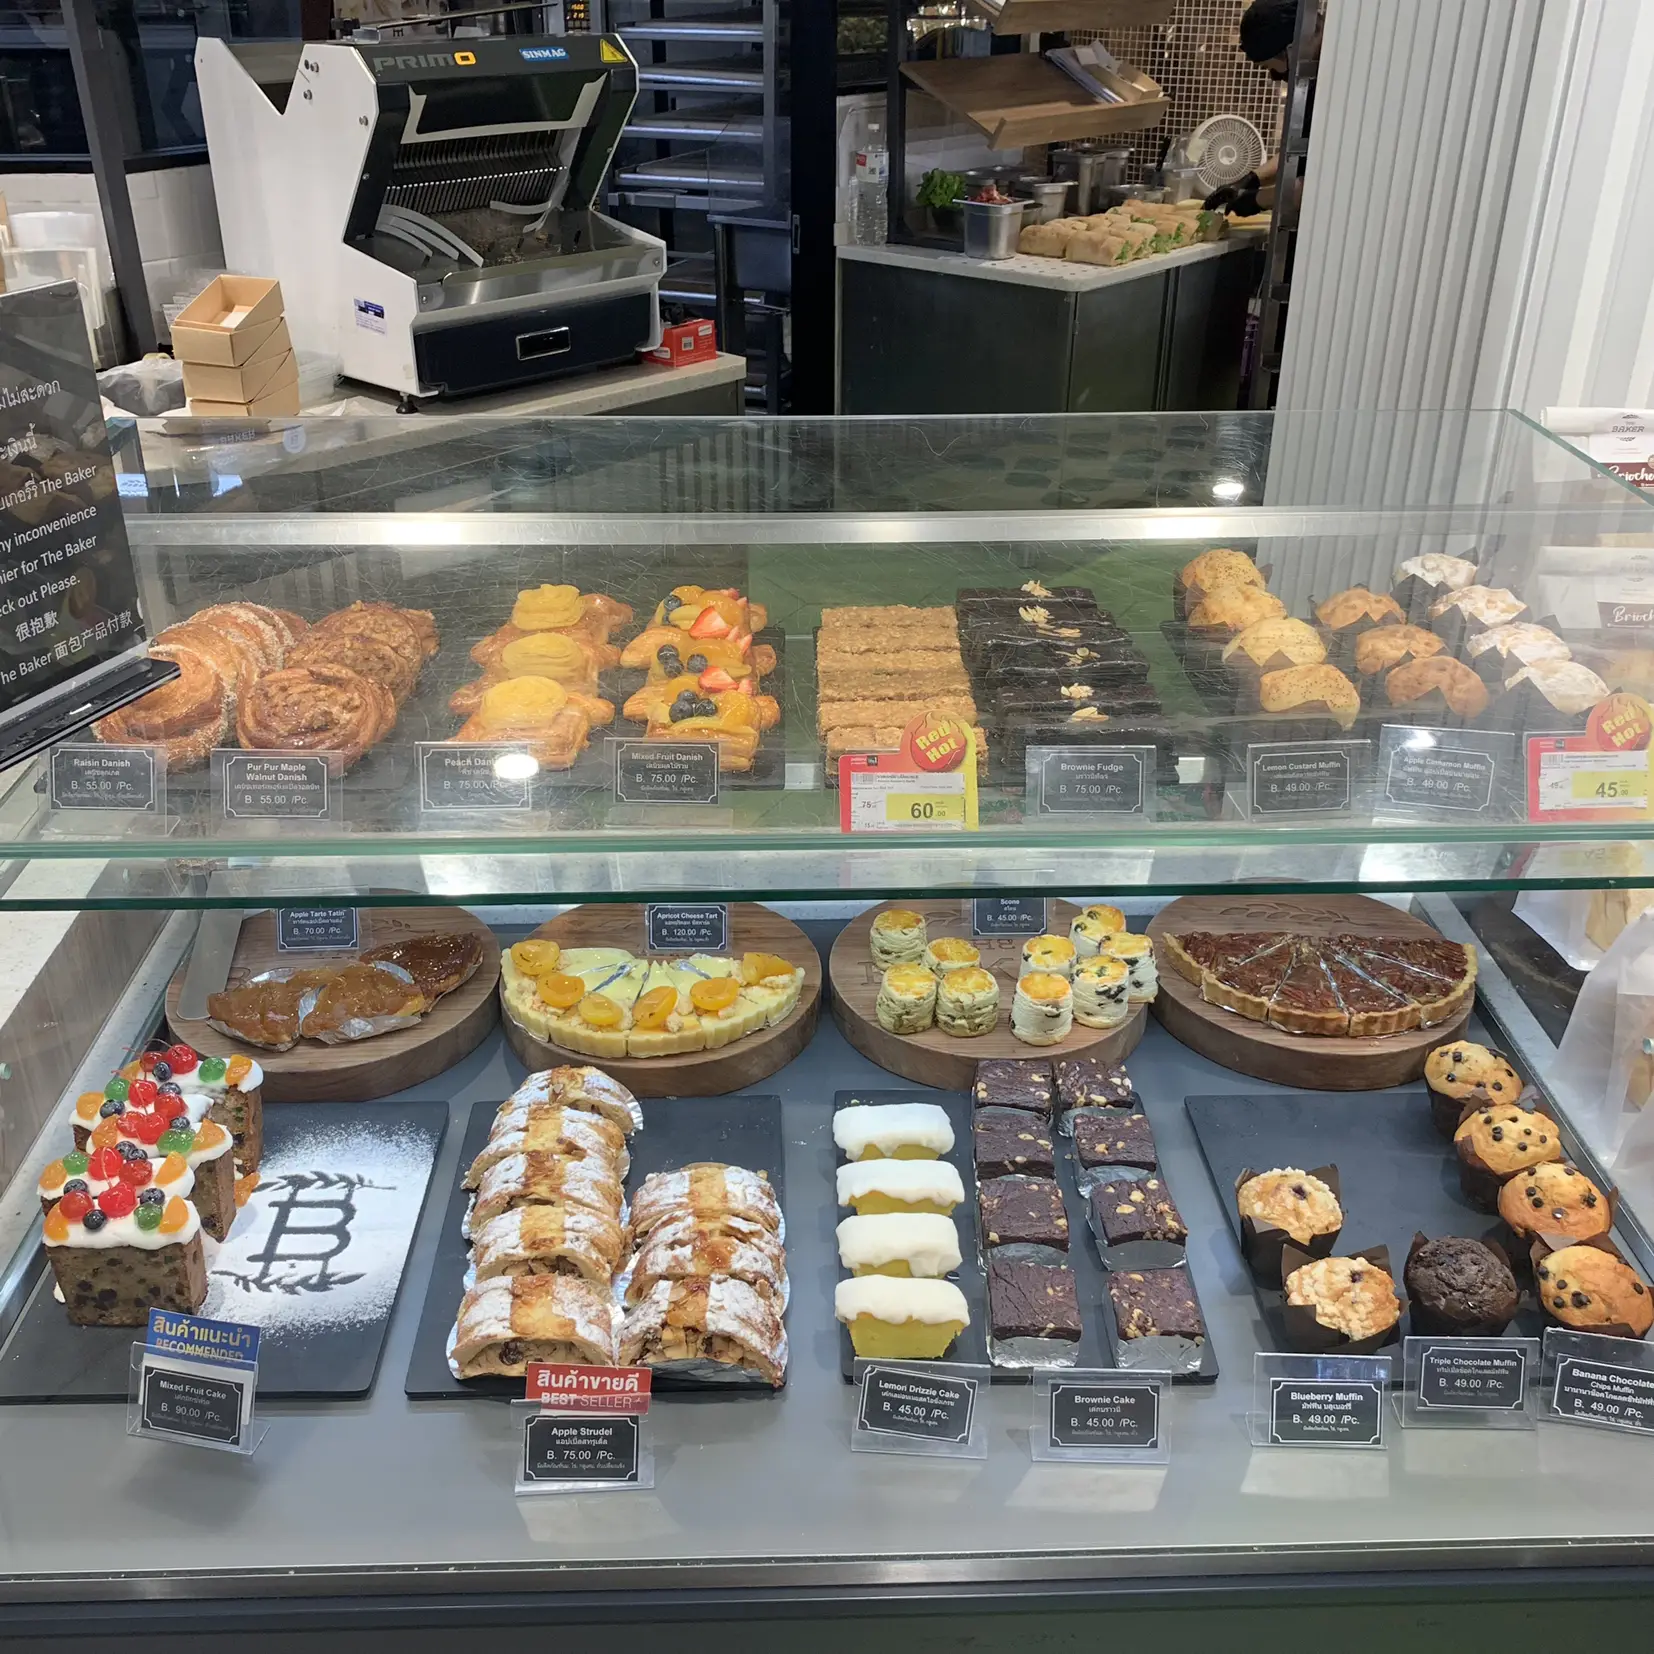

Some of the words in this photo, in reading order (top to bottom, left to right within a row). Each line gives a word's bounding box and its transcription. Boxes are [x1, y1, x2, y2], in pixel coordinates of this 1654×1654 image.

[521, 48, 566, 59] SINMAG
[373, 51, 477, 71] PRIMO
[1612, 425, 1645, 433] BAKER
[40, 478, 63, 494] The
[64, 465, 97, 486] Baker
[13, 506, 97, 547] inconvenience
[20, 559, 39, 575] for
[40, 550, 63, 567] The
[65, 535, 97, 557] Baker
[17, 590, 39, 608] out
[40, 574, 81, 599] Please.
[15, 610, 60, 642] 很抱歉
[18, 652, 52, 676] Baker
[53, 610, 133, 660] 面包产品付款
[915, 719, 951, 750] Red
[926, 736, 958, 763] Hot
[445, 758, 472, 767] Peach
[676, 753, 703, 761] Danish
[73, 758, 100, 767] Raisin
[101, 759, 131, 768] Danish
[247, 763, 262, 771] Pur
[264, 763, 279, 771] Pur
[280, 763, 307, 773] Maple
[1061, 763, 1095, 771] Brownie
[1097, 763, 1124, 773] Fudge
[1288, 762, 1317, 770] Custard
[1319, 761, 1341, 769] Muffin
[246, 773, 277, 781] Walnut
[278, 773, 307, 781] Danish
[651, 774, 676, 783] 75.00
[86, 781, 112, 790] 55.00
[1075, 785, 1101, 794] 75.00
[1596, 782, 1618, 798] 45
[260, 795, 286, 804] 55.00
[911, 802, 934, 819] 60
[290, 911, 309, 919] Apple
[153, 1315, 251, 1349] สินค้าแนะนำ
[1430, 1357, 1451, 1367] Triple
[1453, 1359, 1491, 1367] Chocolate
[1493, 1359, 1517, 1367] Muffin
[537, 1369, 639, 1392] สินค้าขายดี
[1439, 1378, 1448, 1387] B.
[1454, 1378, 1481, 1388] 49.00
[1572, 1368, 1607, 1381] Banana
[1609, 1374, 1654, 1389] Chocolate
[160, 1380, 183, 1392] Mixed
[185, 1384, 204, 1395] Fruit
[205, 1387, 227, 1399] Cake
[879, 1380, 907, 1391] Lemon
[909, 1384, 937, 1396] Drizzle
[939, 1387, 960, 1399] Cake
[1590, 1381, 1612, 1391] Chips
[1613, 1384, 1635, 1394] Muffin
[540, 1392, 577, 1406] BEST
[580, 1394, 632, 1409] SELLER
[1075, 1395, 1111, 1404] Brownie
[1113, 1395, 1135, 1404] Cake
[1291, 1392, 1333, 1402] Blueberry
[1335, 1392, 1363, 1401] Muffin
[161, 1402, 170, 1412] B.
[175, 1405, 200, 1418] 90.00
[883, 1402, 892, 1412] B.
[898, 1404, 926, 1417] 45.00
[930, 1409, 949, 1420] /Pc.
[1574, 1398, 1585, 1408] B.
[1590, 1401, 1620, 1414] 49.00
[1624, 1407, 1644, 1419] /Pc.
[1070, 1417, 1080, 1427] B.
[1086, 1418, 1114, 1428] 45.00
[1119, 1418, 1138, 1428] /Pc.
[1292, 1414, 1302, 1424] B.
[1308, 1415, 1336, 1424] 49.00
[1340, 1415, 1360, 1425] /Pc.
[551, 1427, 578, 1437] Apple
[580, 1427, 613, 1436] Strudel
[546, 1450, 557, 1460] B.
[563, 1450, 591, 1460] 75.00
[596, 1450, 616, 1461] /Pc.
